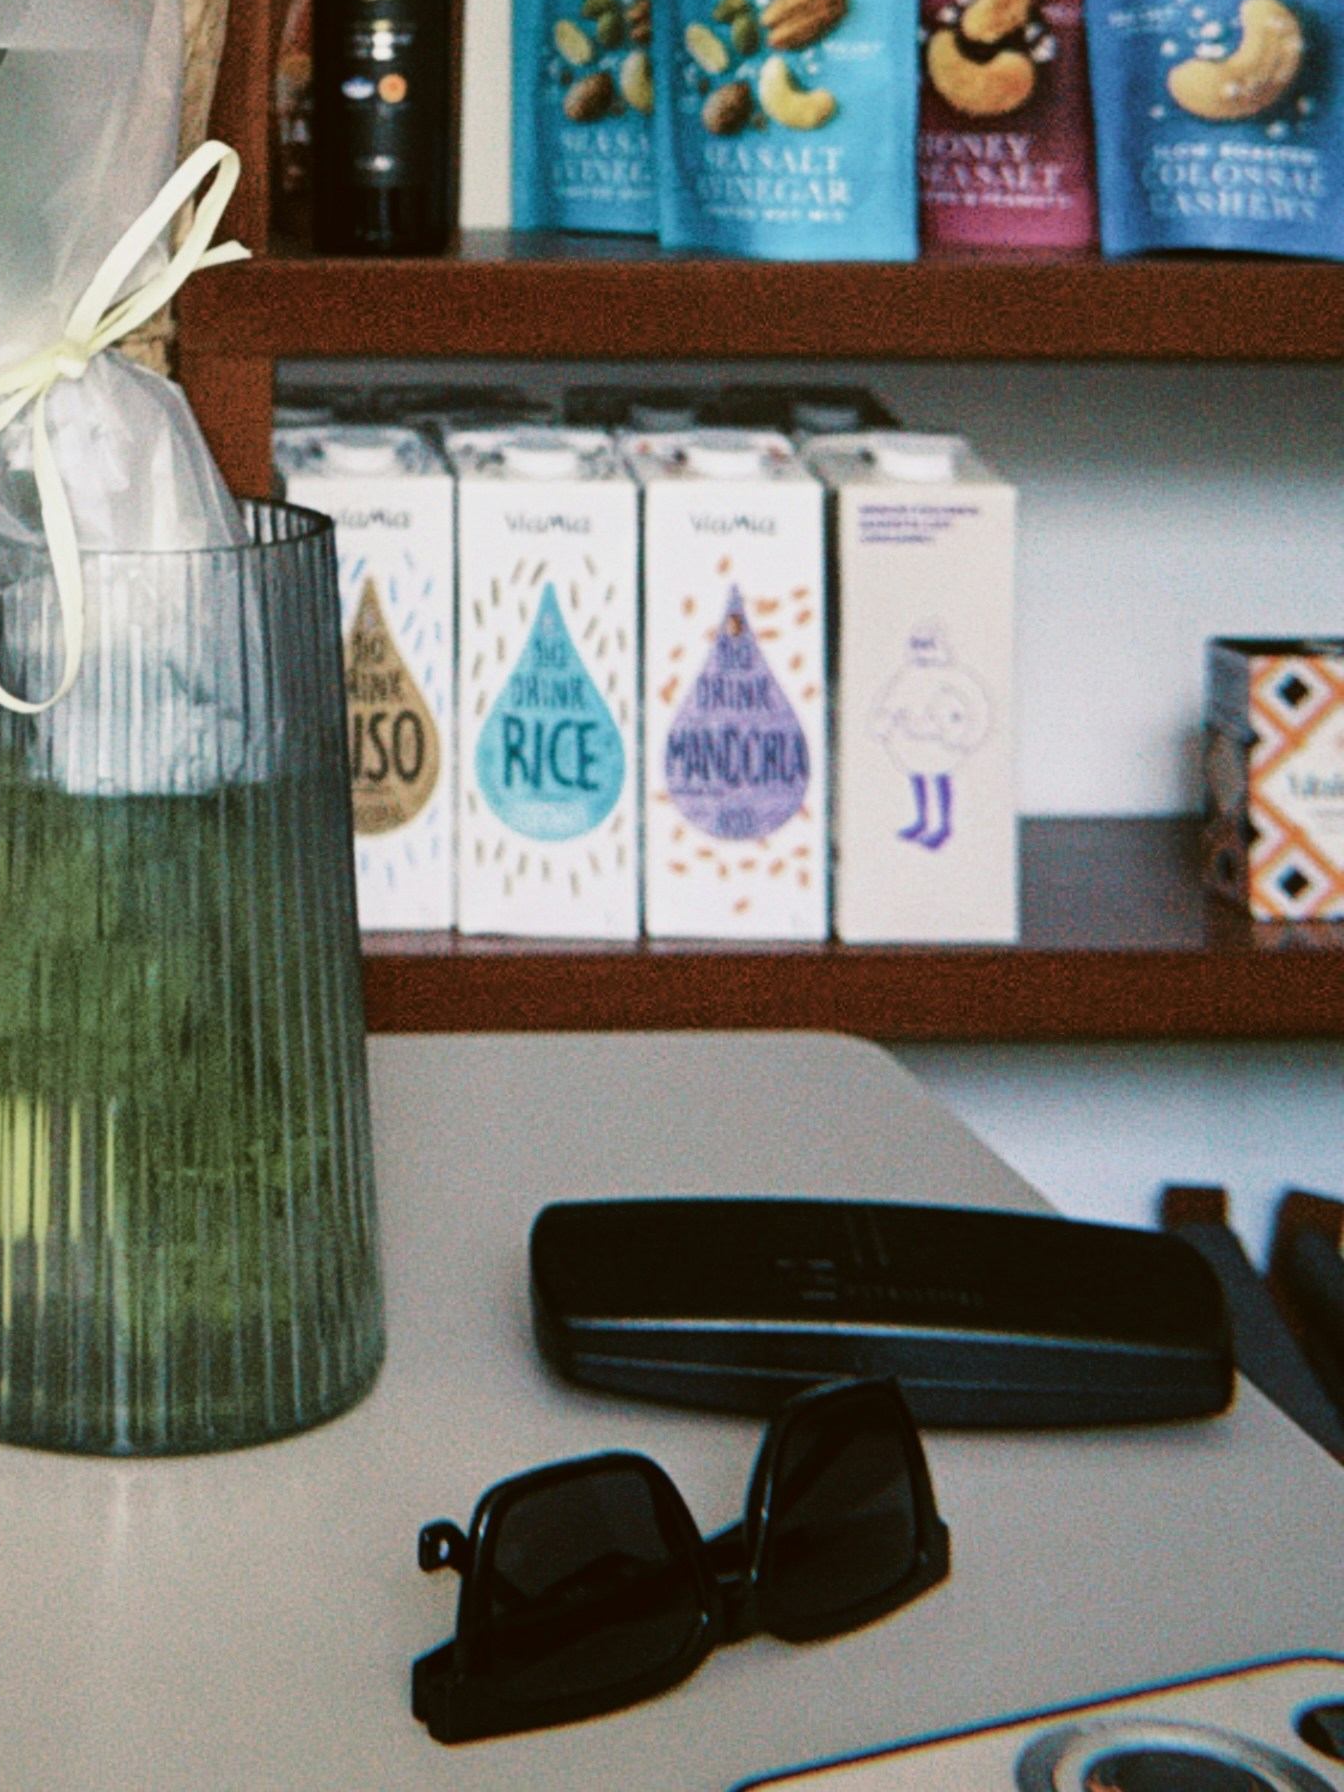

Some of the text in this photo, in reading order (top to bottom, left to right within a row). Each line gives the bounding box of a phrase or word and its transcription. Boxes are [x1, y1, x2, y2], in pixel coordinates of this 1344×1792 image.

[511, 671, 586, 709] DRINK
[696, 675, 772, 711] DRINK
[353, 709, 426, 783] ISO
[502, 712, 600, 792] RICE
[665, 723, 812, 790] MANDORLA
